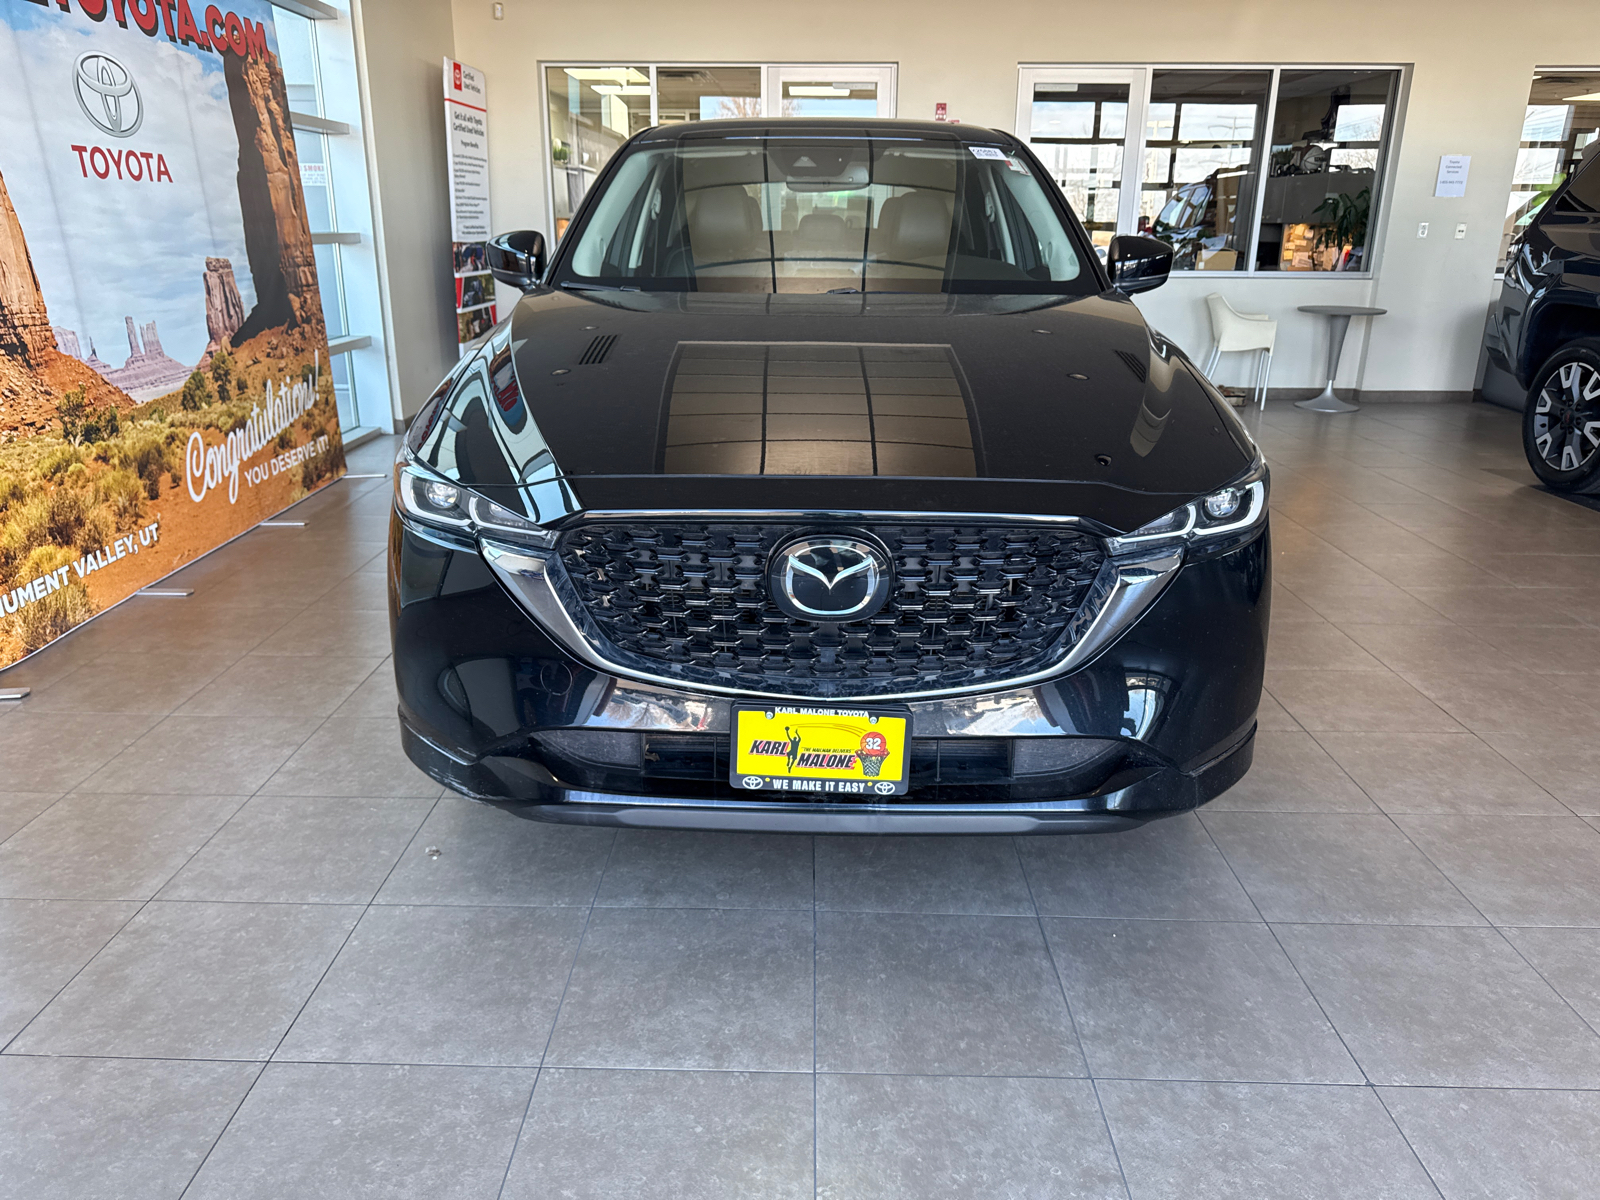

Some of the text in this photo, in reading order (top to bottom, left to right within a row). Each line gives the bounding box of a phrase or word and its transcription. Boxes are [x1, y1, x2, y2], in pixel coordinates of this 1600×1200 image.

[71, 144, 174, 183] TOYOTA
[186, 349, 319, 504] Congratulations!
[244, 434, 329, 487] YOU DESERVE IT!
[72, 533, 139, 579] VALLEY,
[138, 522, 159, 547] UT
[775, 706, 870, 718] KARL MALONE TOYOTA
[749, 740, 790, 757] KARL
[865, 737, 881, 750] 32
[796, 753, 857, 770] MALONE
[773, 779, 865, 793] WE MAKE IT EASY
